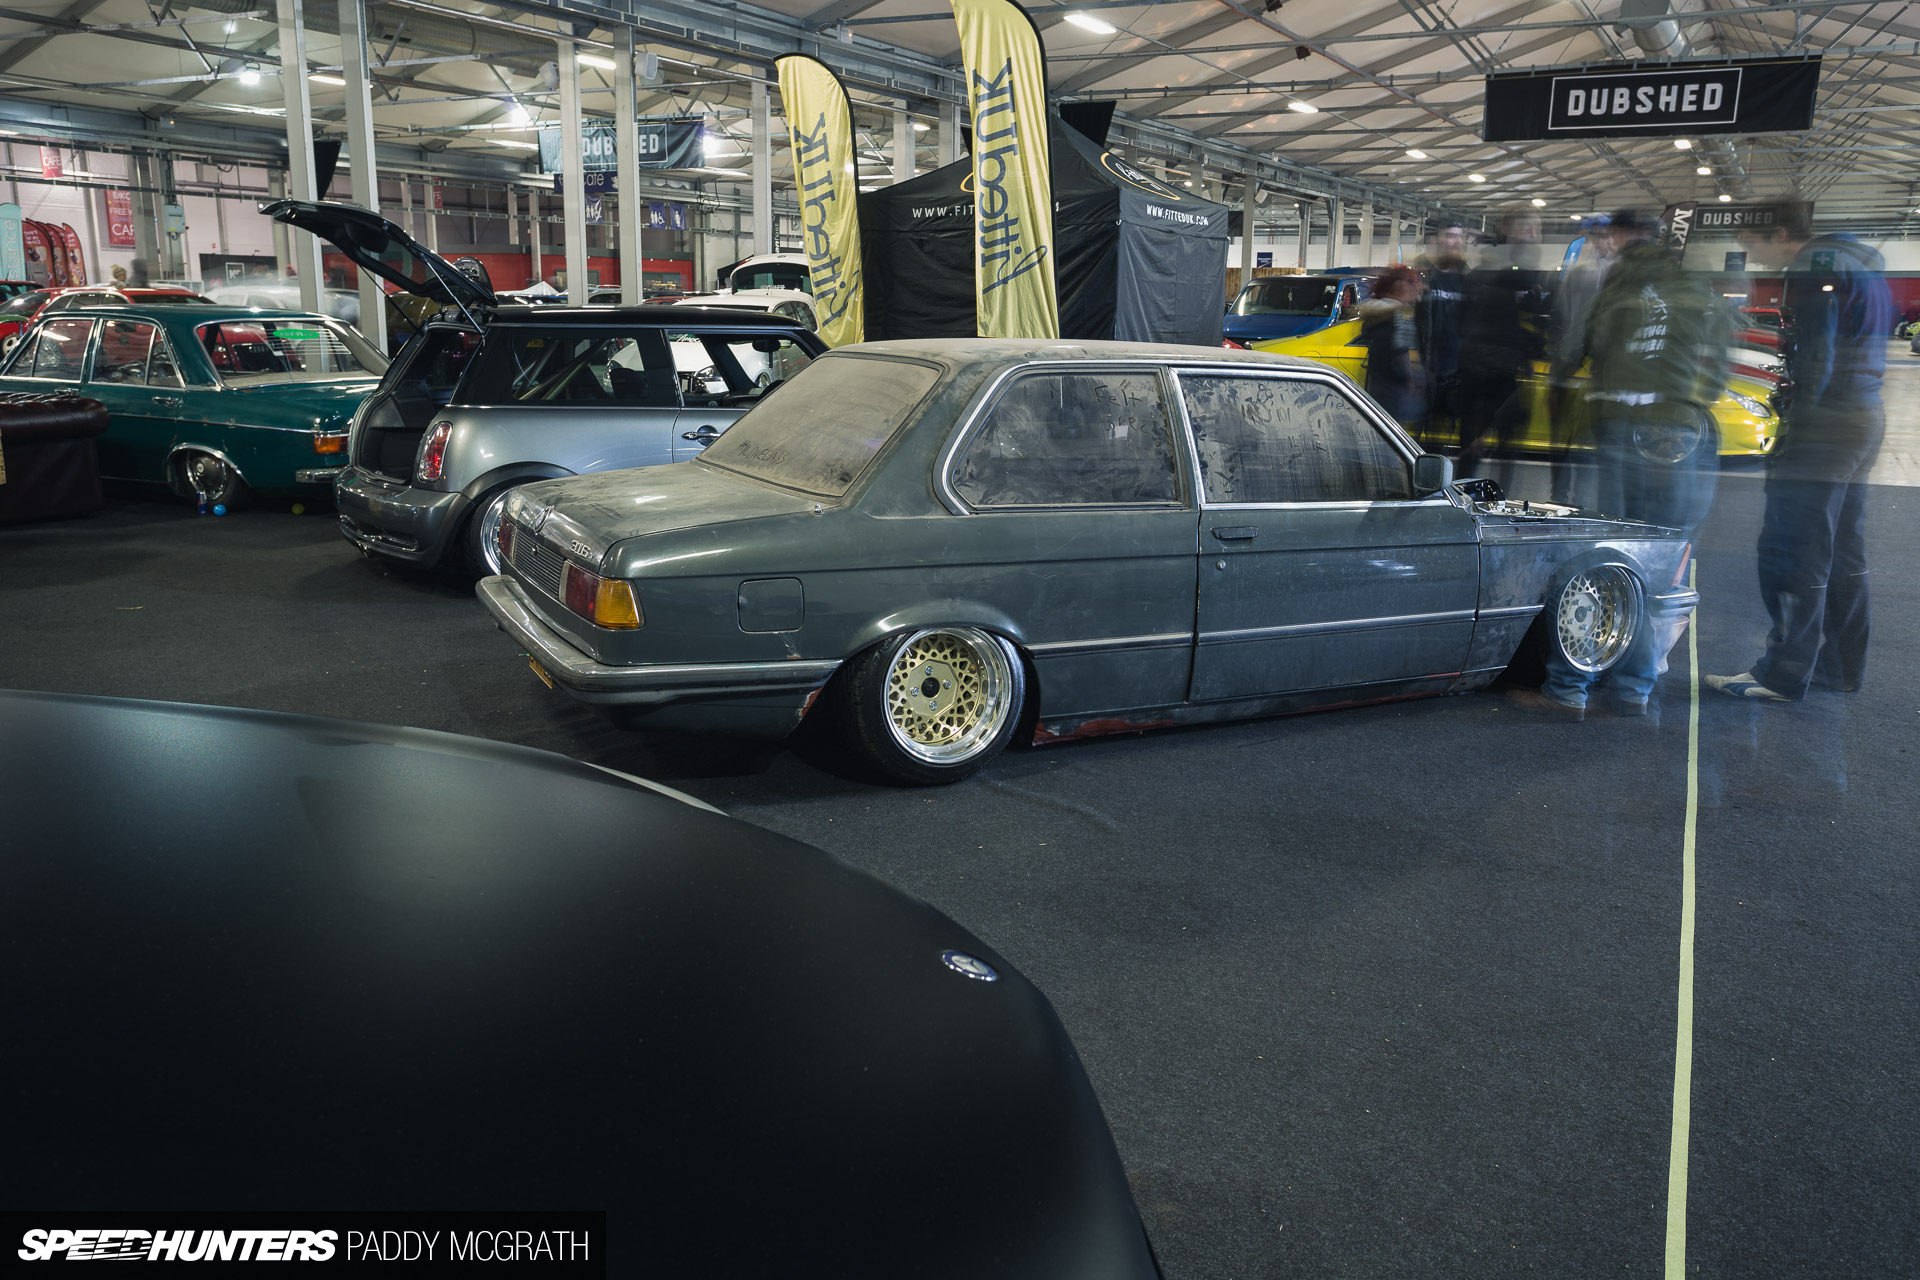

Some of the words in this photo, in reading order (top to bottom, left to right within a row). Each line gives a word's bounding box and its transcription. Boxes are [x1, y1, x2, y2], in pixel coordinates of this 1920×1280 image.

[1567, 83, 1723, 116] DUBSHED
[582, 134, 659, 156] DUBED
[1703, 212, 1773, 225] DUBSHED
